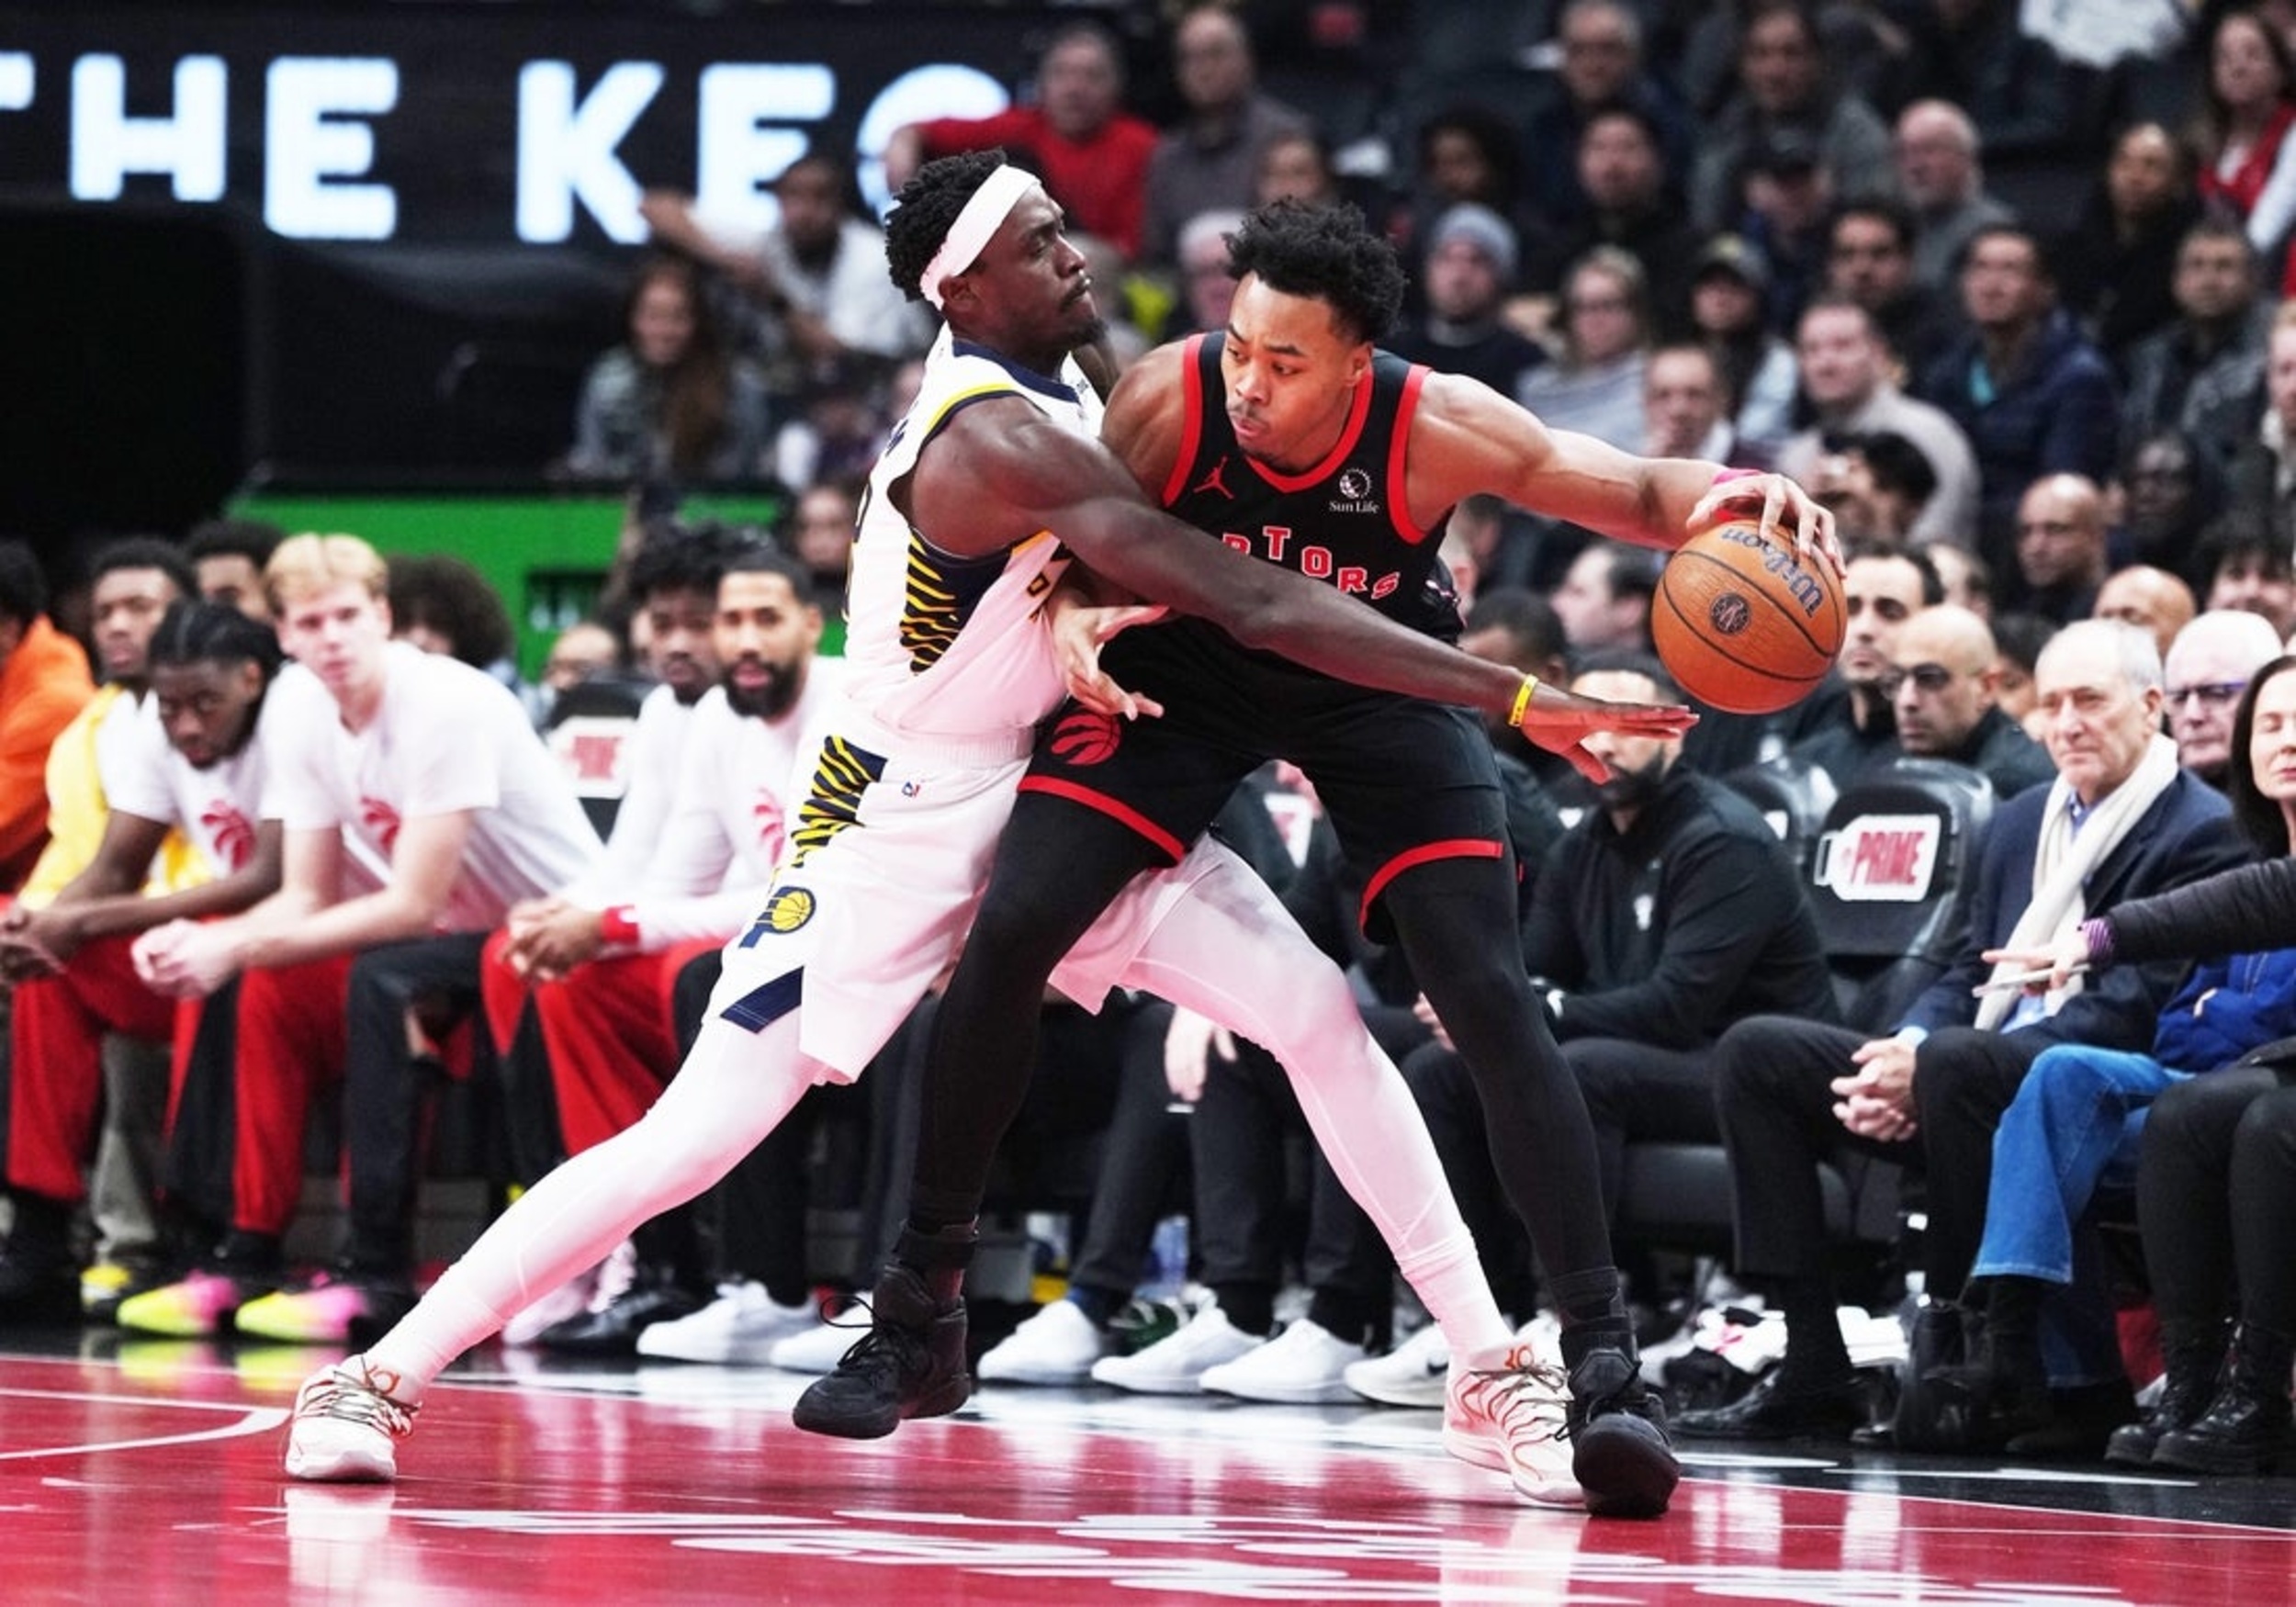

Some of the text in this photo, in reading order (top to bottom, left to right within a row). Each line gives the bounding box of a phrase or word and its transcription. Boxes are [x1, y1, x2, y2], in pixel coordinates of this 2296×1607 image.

[0, 52, 401, 241] HE
[1329, 500, 1380, 514] Sun Life
[1720, 527, 1824, 618] Wilson
[1850, 831, 1925, 884] PRIME
